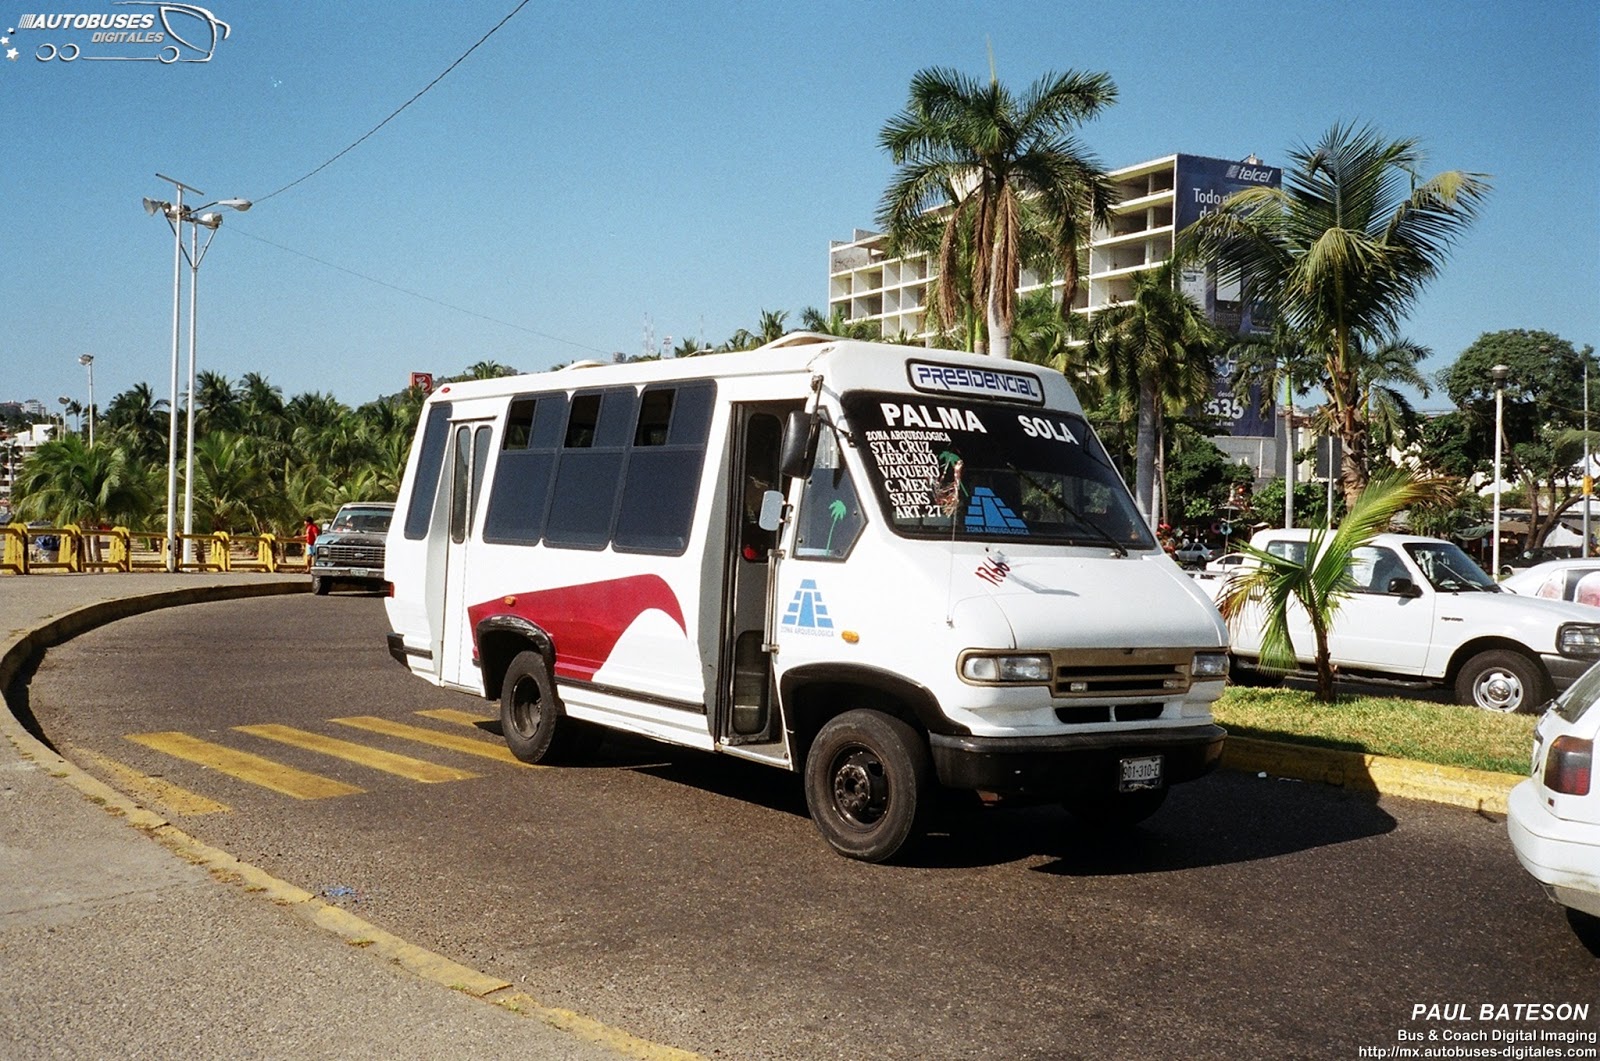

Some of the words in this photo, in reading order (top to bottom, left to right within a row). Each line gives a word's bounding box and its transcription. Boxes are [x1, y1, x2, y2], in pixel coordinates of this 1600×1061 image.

[1238, 167, 1273, 182] telcel
[1193, 188, 1220, 204] Todo
[880, 403, 987, 433] PALMA
[1017, 415, 1079, 445] SOLA
[865, 431, 890, 441] ZONA
[870, 441, 899, 454] STA.
[898, 441, 933, 454] CRUZ
[875, 453, 938, 466] MERCADO
[879, 465, 940, 480] VAQUERO
[885, 480, 899, 493] C.
[890, 492, 930, 506] SEARS
[896, 505, 925, 519] ART.
[925, 505, 942, 518] 27
